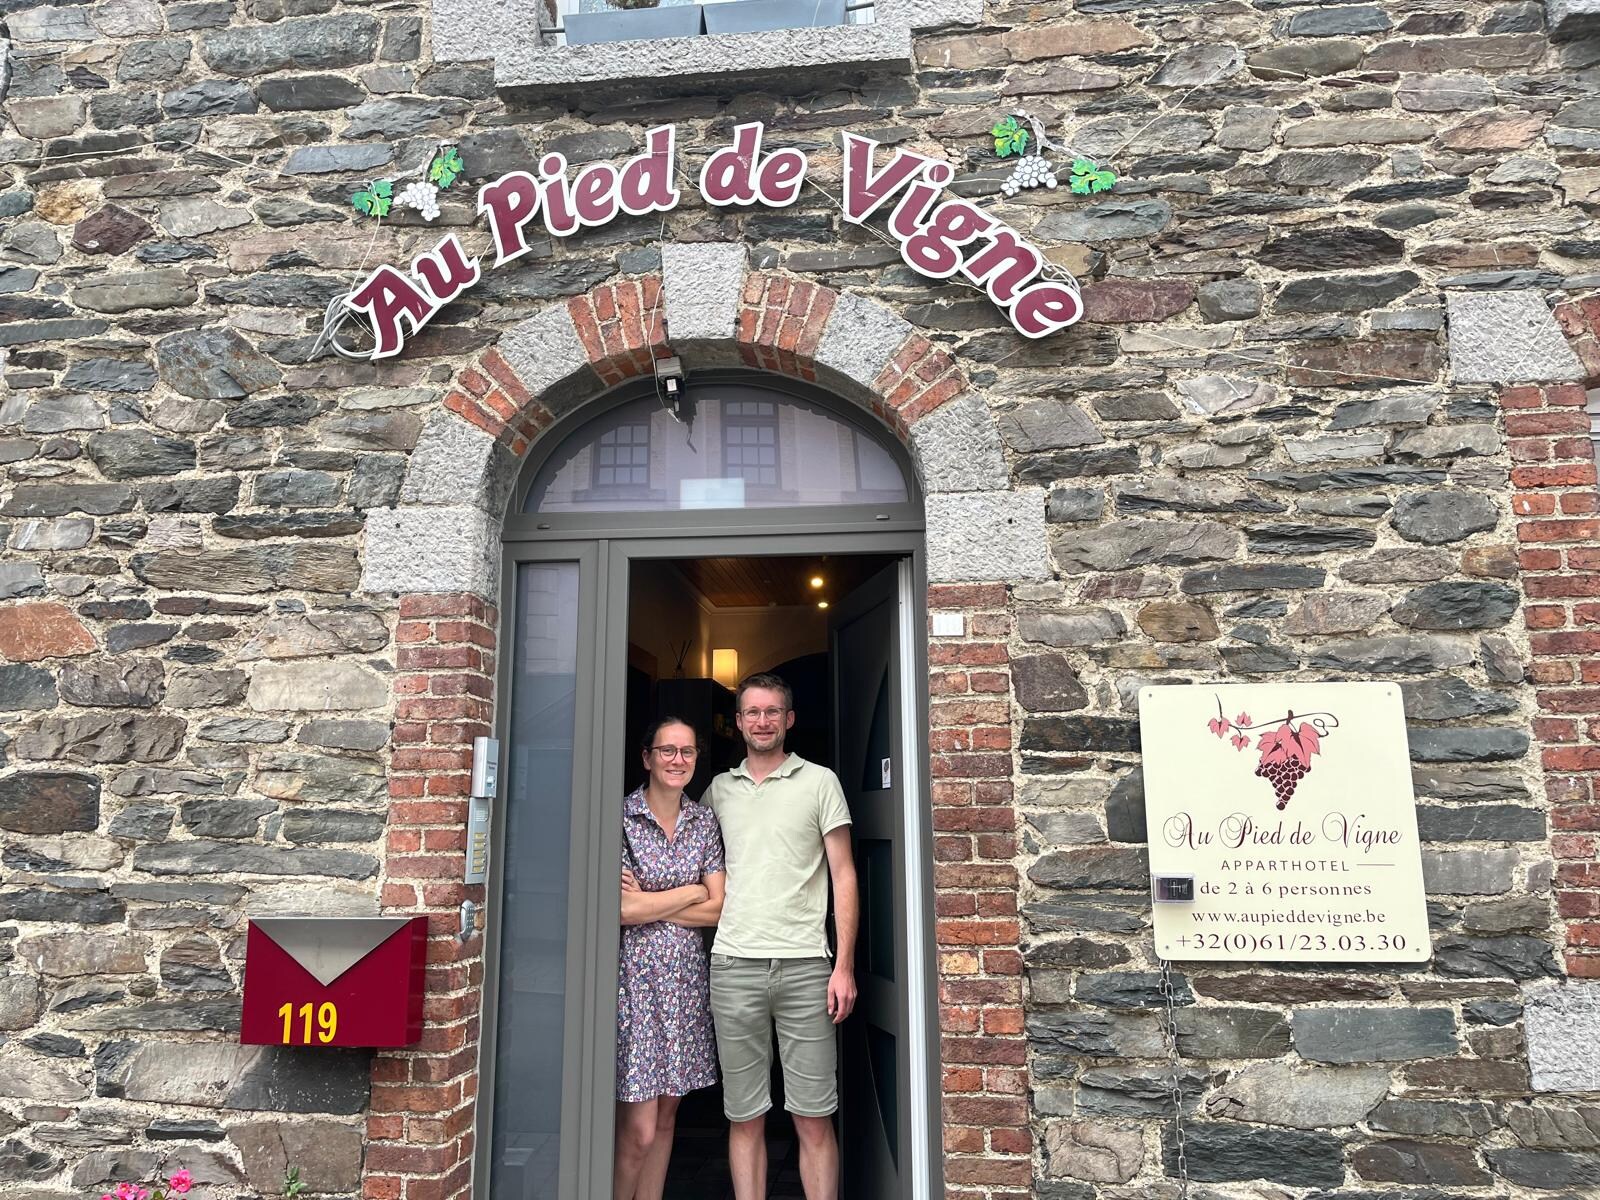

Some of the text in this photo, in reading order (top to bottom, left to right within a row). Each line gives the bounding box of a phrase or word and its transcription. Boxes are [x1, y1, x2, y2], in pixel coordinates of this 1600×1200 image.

[351, 121, 1084, 359] Au Pied de Vigne
[1163, 812, 1402, 853] Au Pied de Vigne
[1221, 860, 1350, 872] APPARTHOTEL
[1200, 882, 1372, 898] de 2 à 6 personnes
[1192, 910, 1386, 927] www.aupieddevigne.be
[1176, 934, 1406, 953] +32(0)61/23.03.30
[278, 1002, 338, 1044] 119
